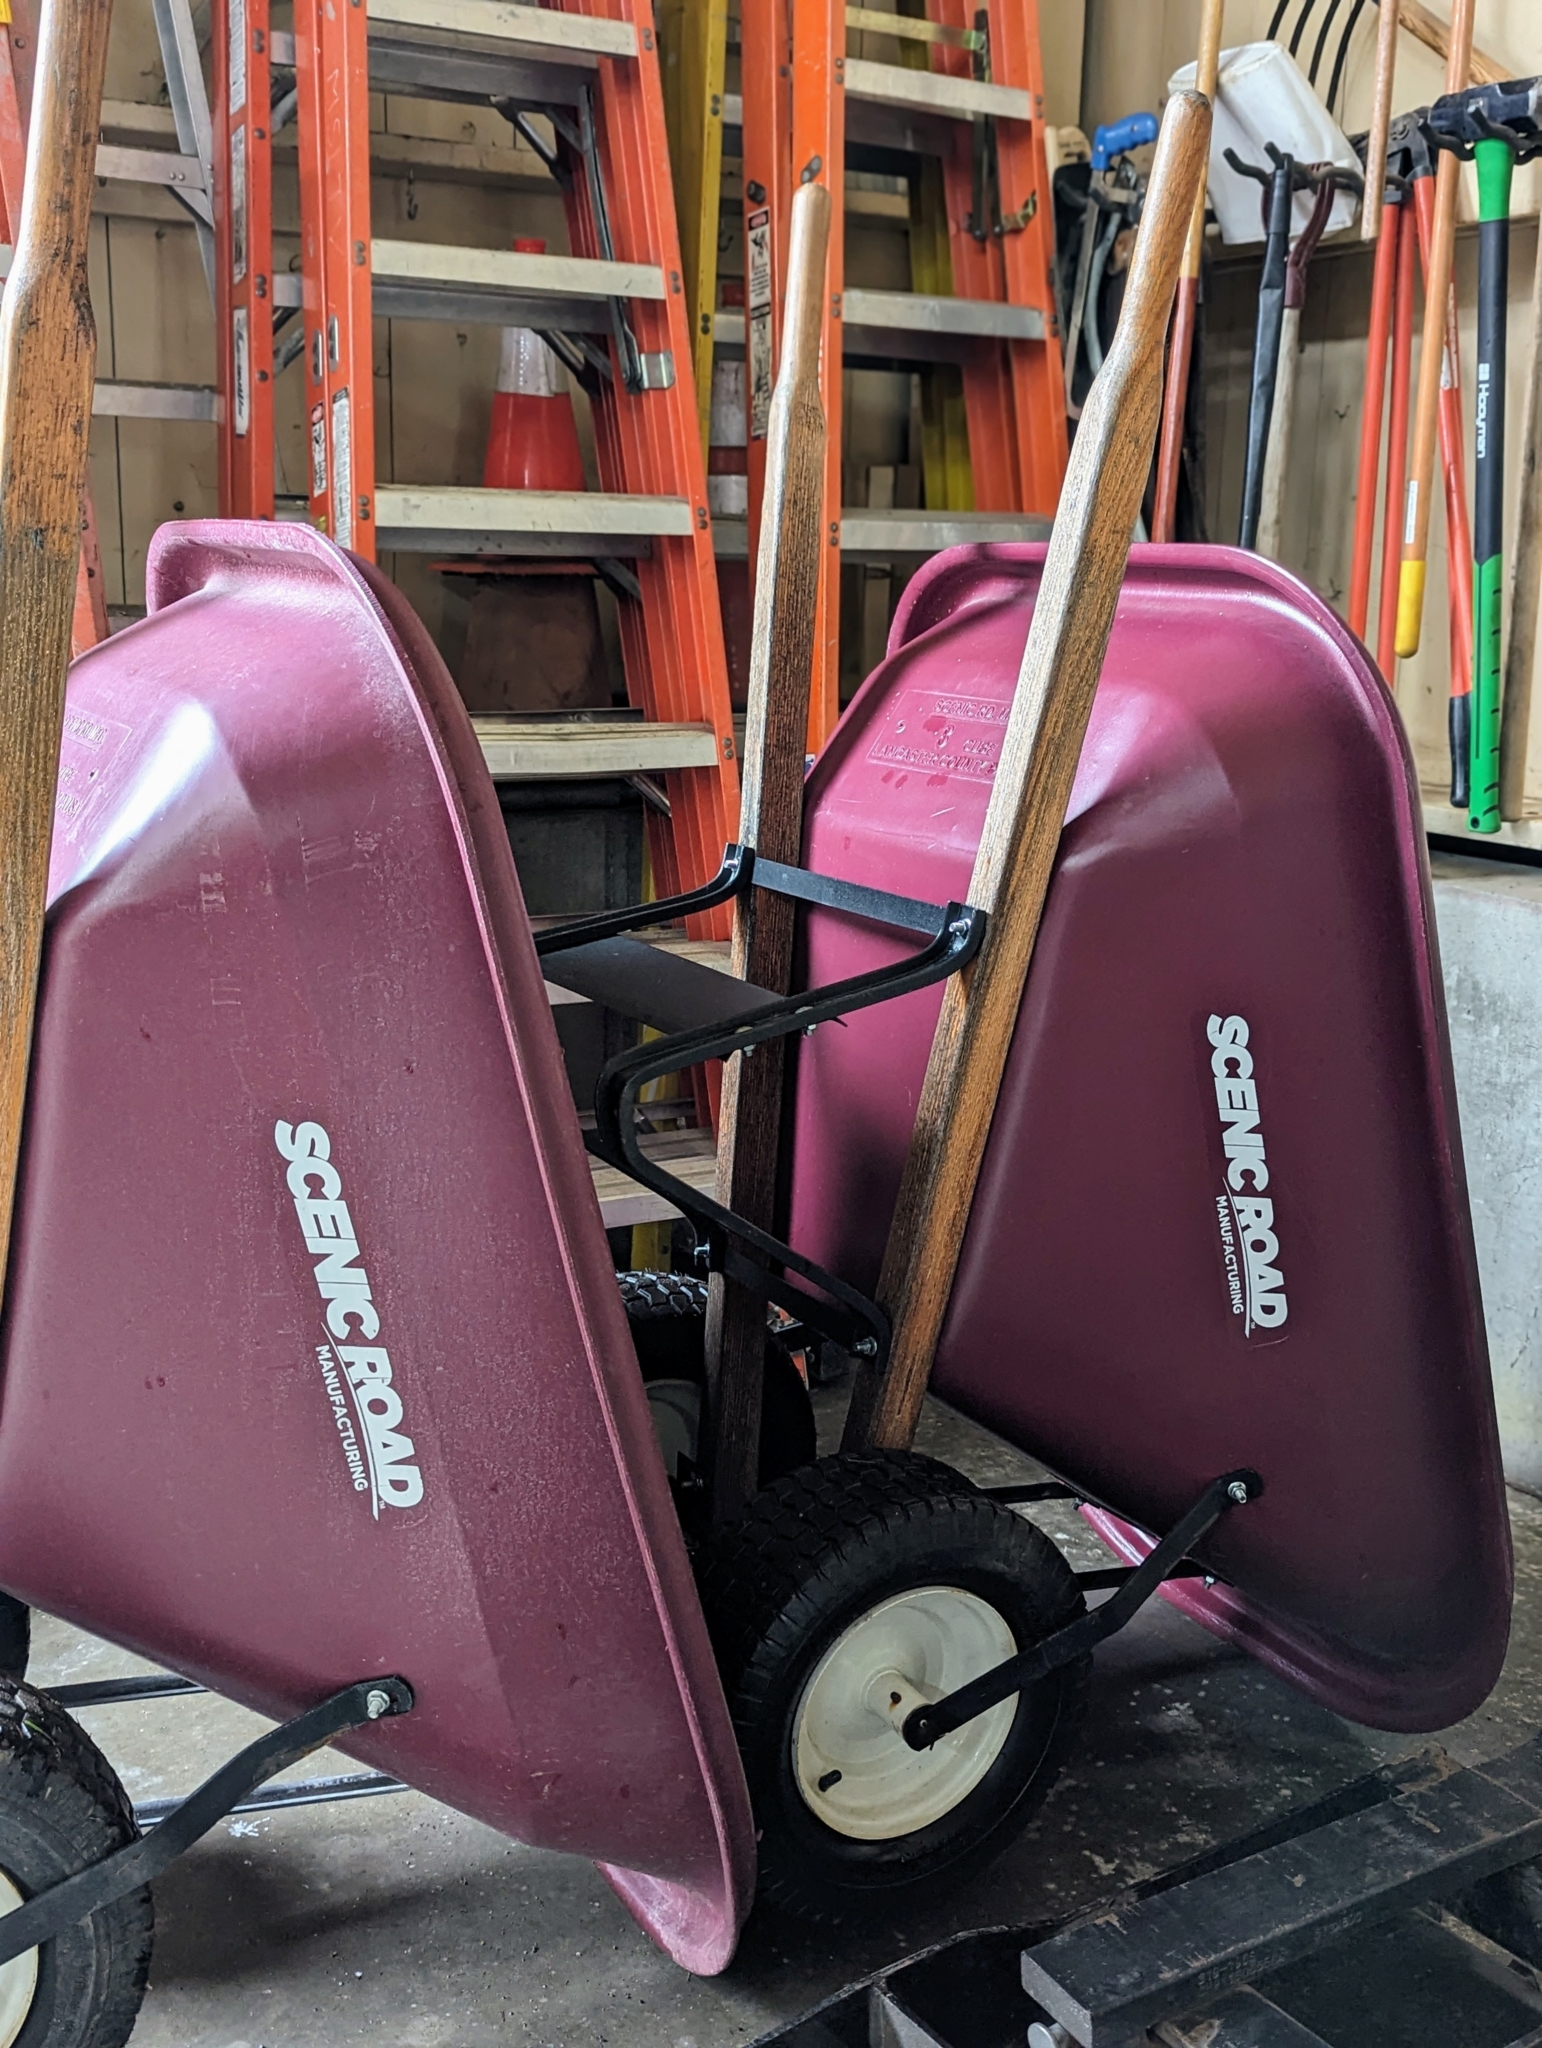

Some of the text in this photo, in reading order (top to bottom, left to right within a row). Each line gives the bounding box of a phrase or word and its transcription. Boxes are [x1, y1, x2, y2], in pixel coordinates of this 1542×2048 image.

[1476, 384, 1489, 458] Hooyman
[871, 743, 940, 766] LANCASTER
[939, 754, 987, 774] COUNTY
[933, 699, 977, 716] SCENIC
[1206, 1013, 1288, 1328] SCENIC ROAD
[274, 1119, 424, 1508] SCENIC ROAD
[1215, 1194, 1244, 1315] MANUFACTURING
[315, 1344, 369, 1491] MANUFACTURING
